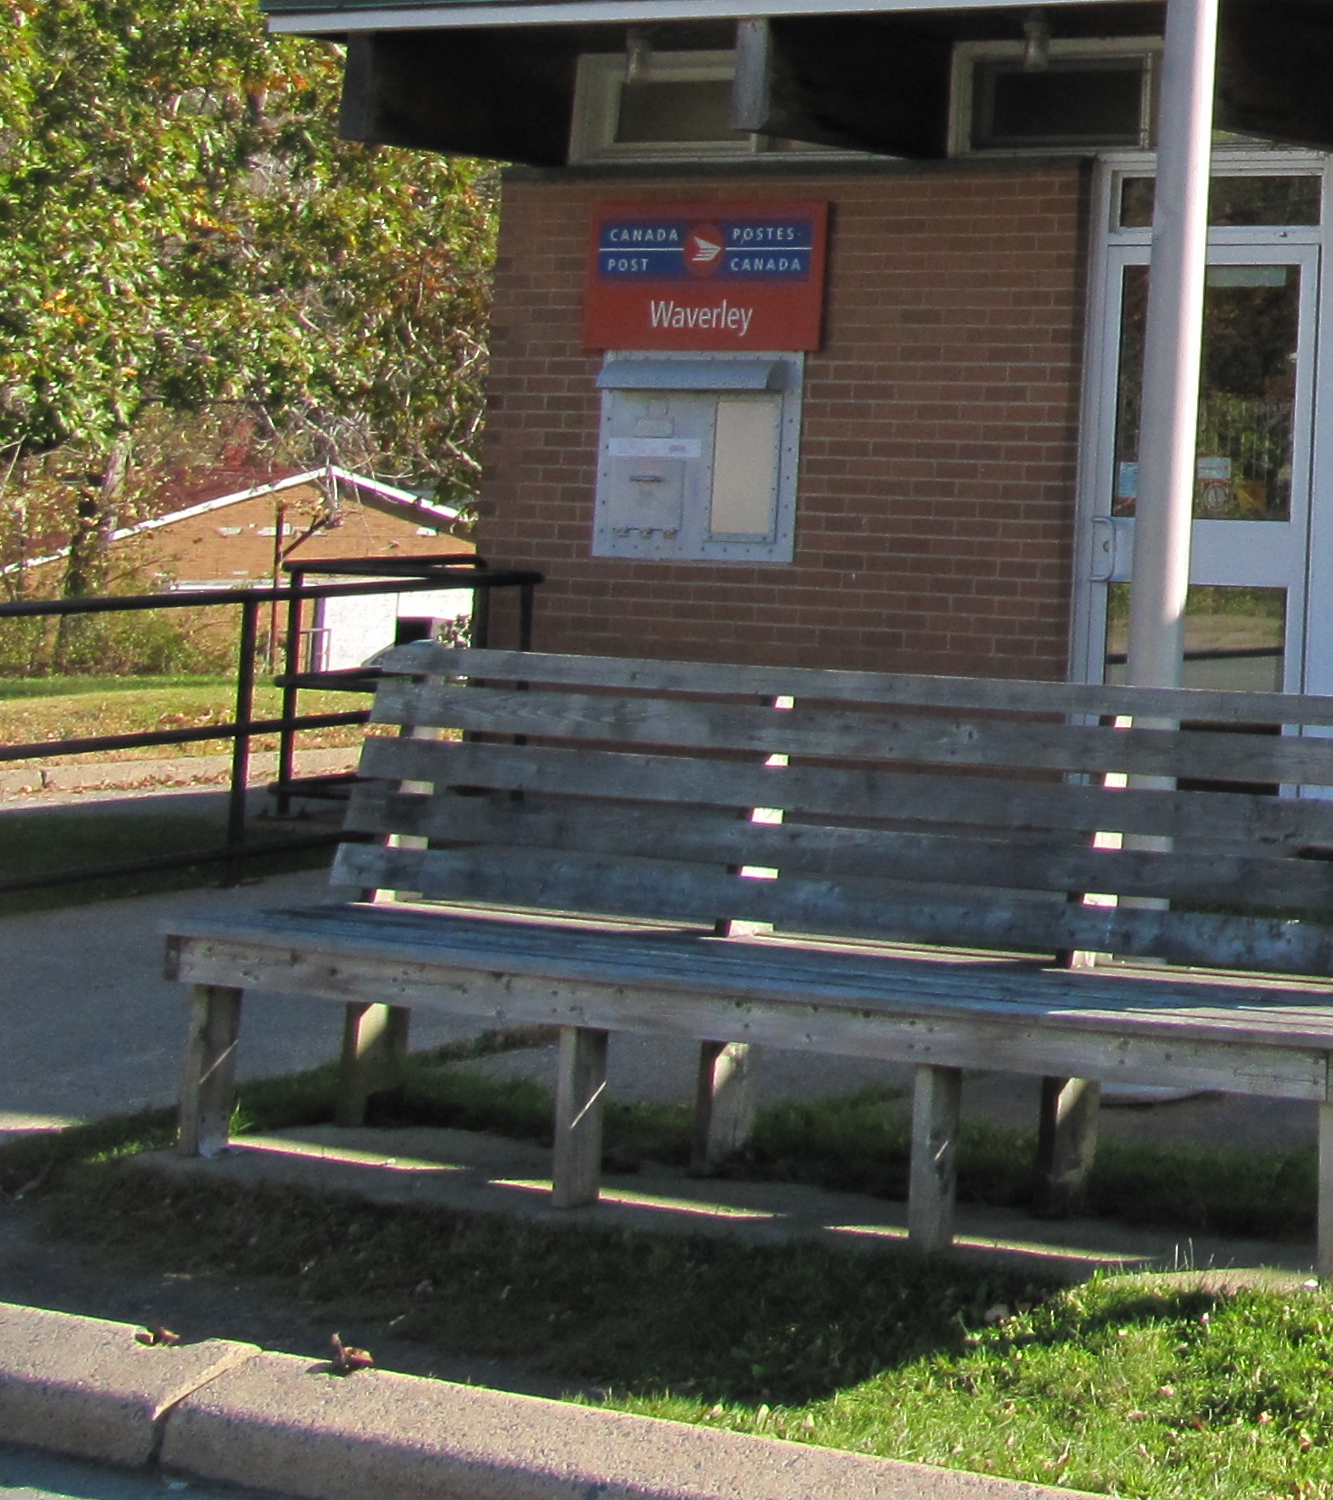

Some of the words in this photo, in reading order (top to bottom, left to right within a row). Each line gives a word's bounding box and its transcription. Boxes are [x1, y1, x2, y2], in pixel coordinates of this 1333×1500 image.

[610, 228, 679, 241] CANADA
[733, 227, 795, 240] POSTES
[608, 258, 649, 271] POST
[731, 258, 801, 271] CANADA
[650, 299, 753, 336] Waverley
